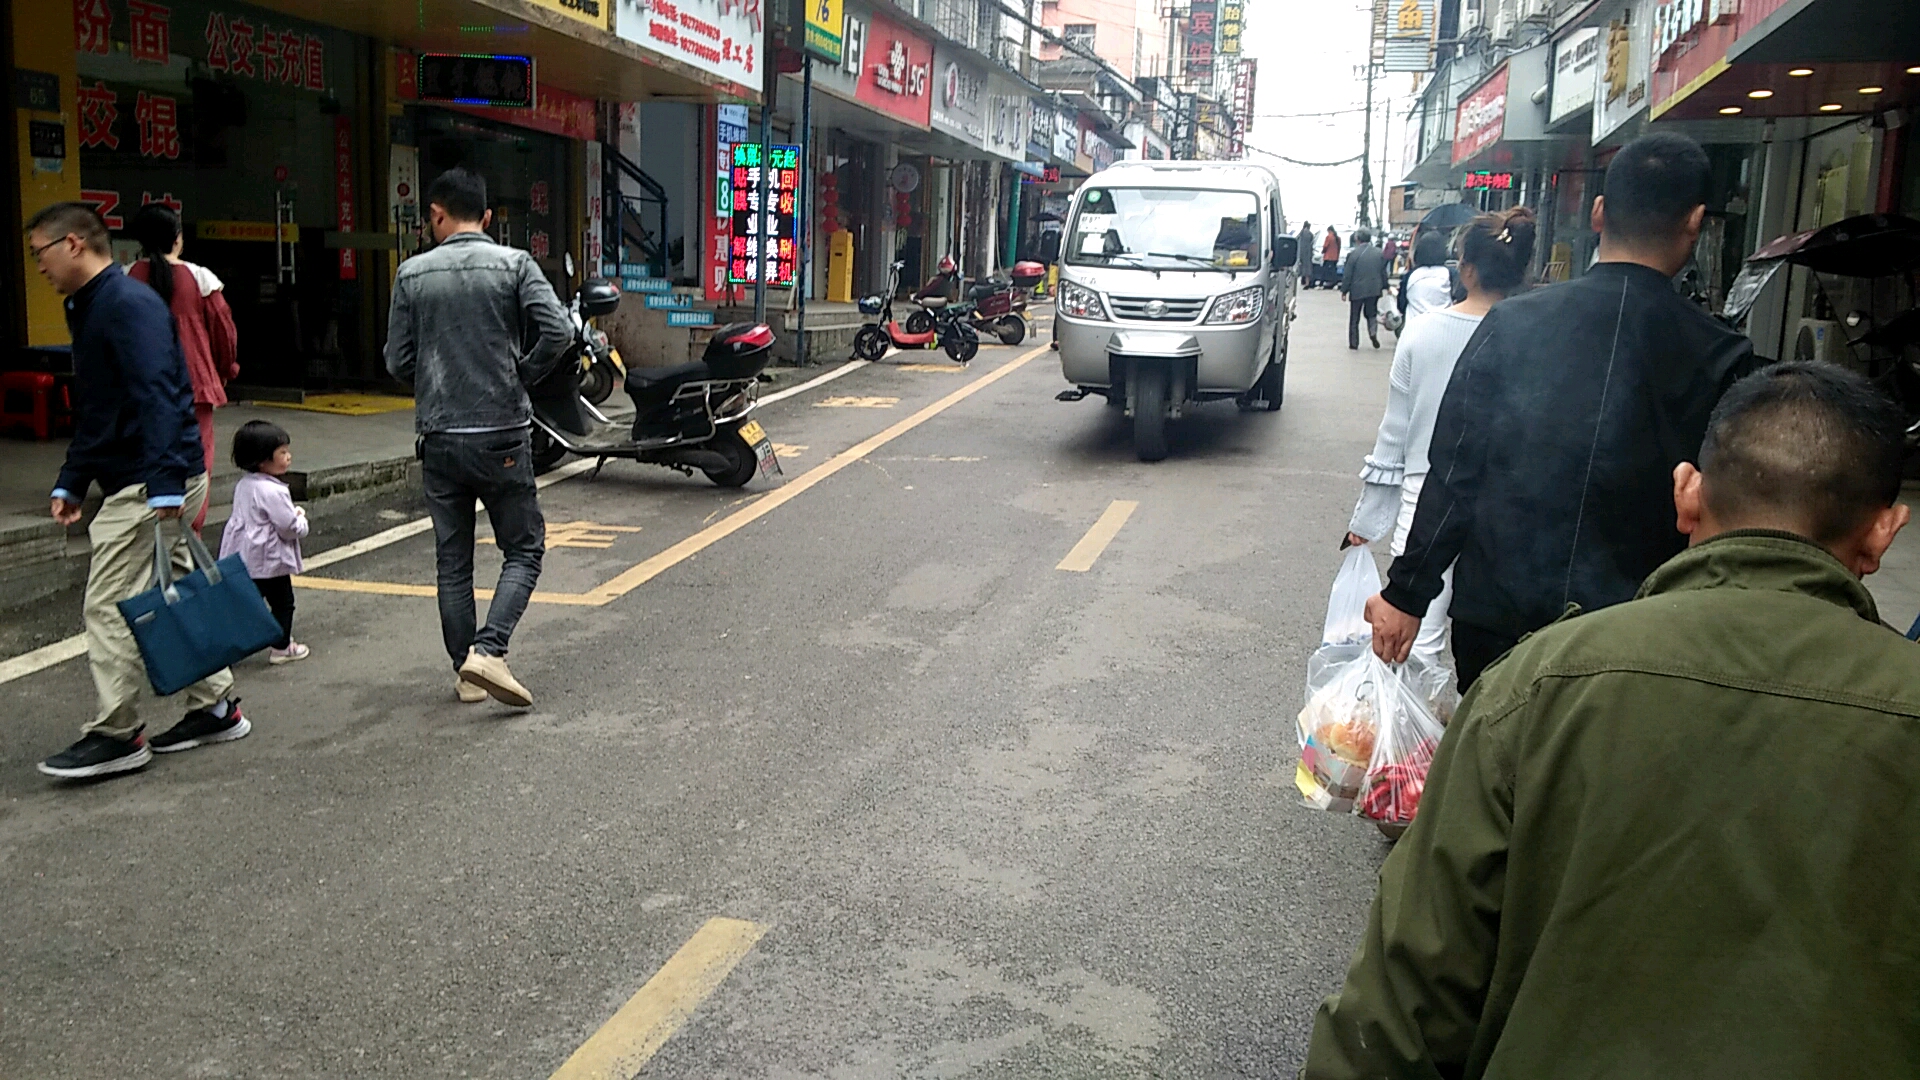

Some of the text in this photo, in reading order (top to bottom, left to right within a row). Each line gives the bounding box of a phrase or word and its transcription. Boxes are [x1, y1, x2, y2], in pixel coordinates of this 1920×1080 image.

[205, 12, 325, 91] 公交卡充值
[1189, 0, 1215, 66] 宾馆
[780, 170, 794, 214] 回收
